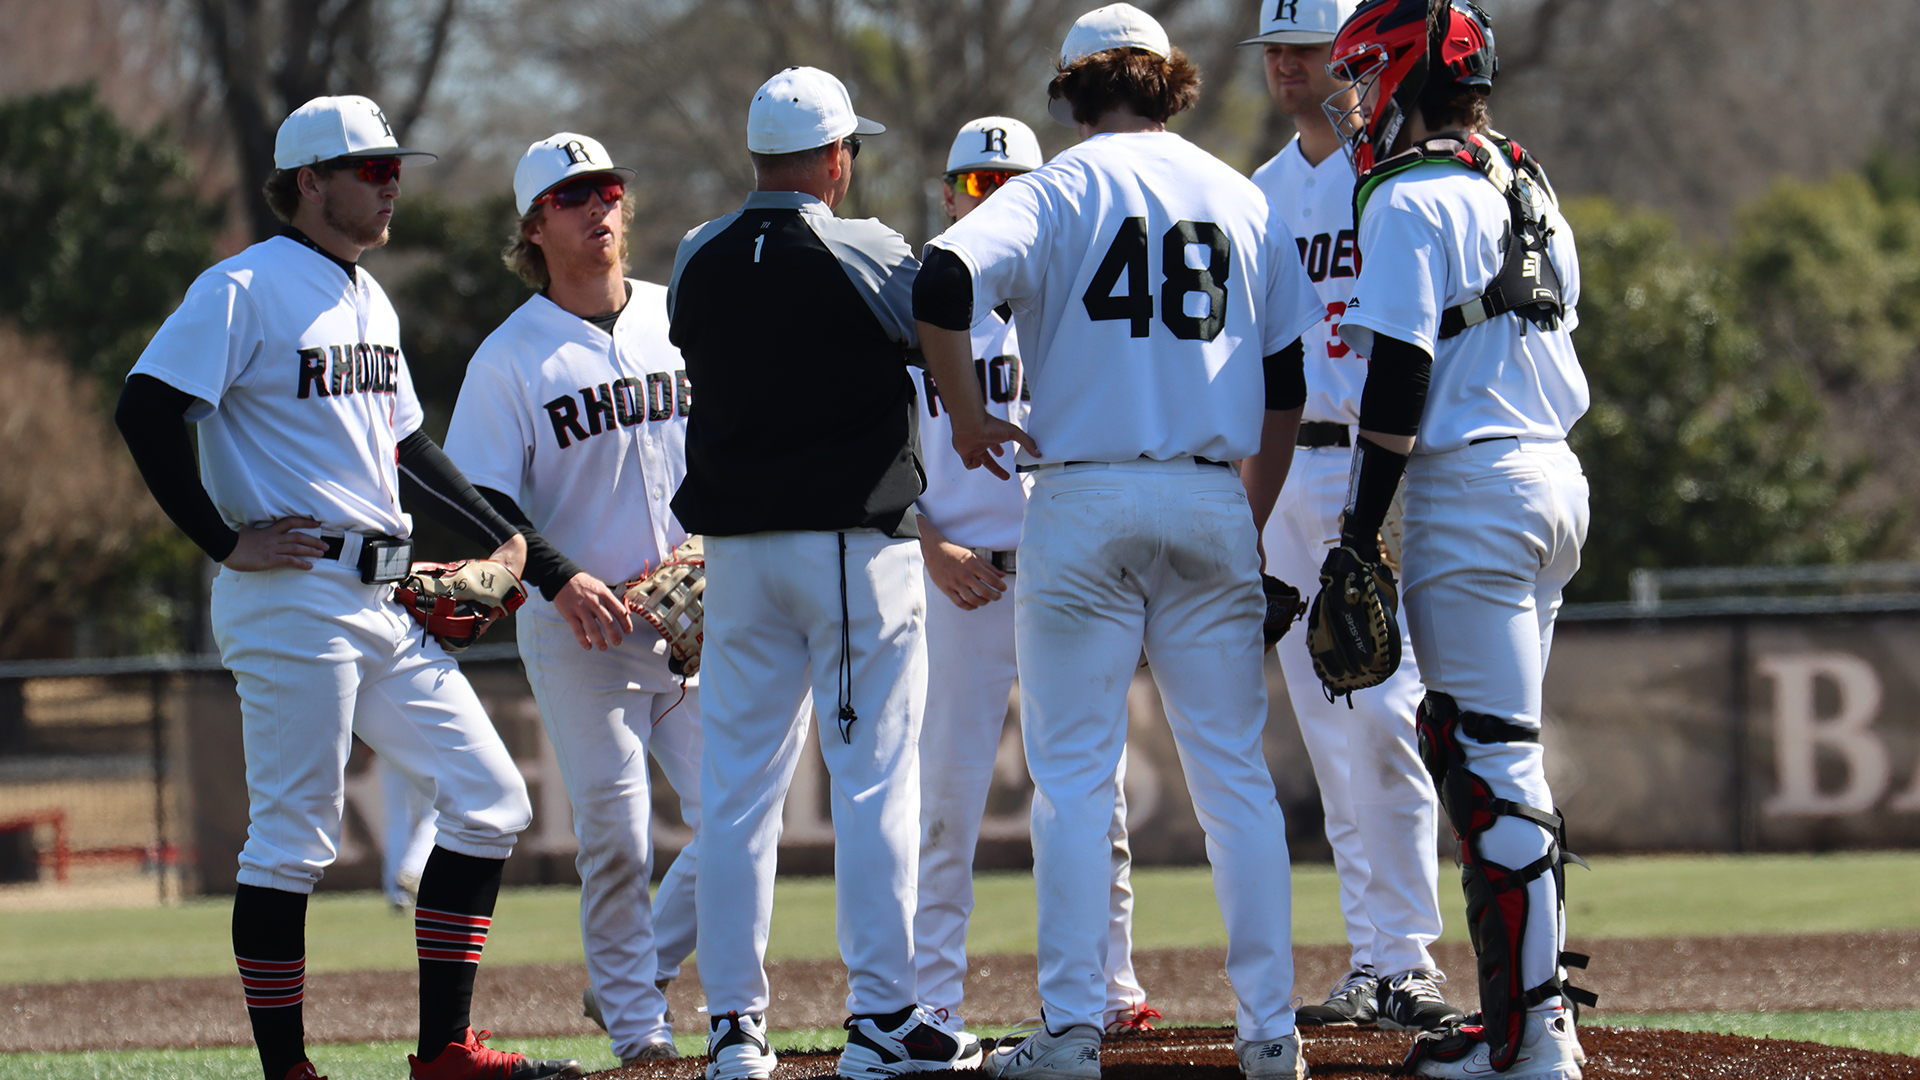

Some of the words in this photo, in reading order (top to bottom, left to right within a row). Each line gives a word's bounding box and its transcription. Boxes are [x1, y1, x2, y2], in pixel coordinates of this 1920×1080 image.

[556, 140, 596, 167] R
[981, 127, 1010, 158] R
[754, 234, 765, 263] 1
[1082, 216, 1231, 343] 48
[296, 342, 399, 399] RHODE
[1755, 650, 1920, 817] B
